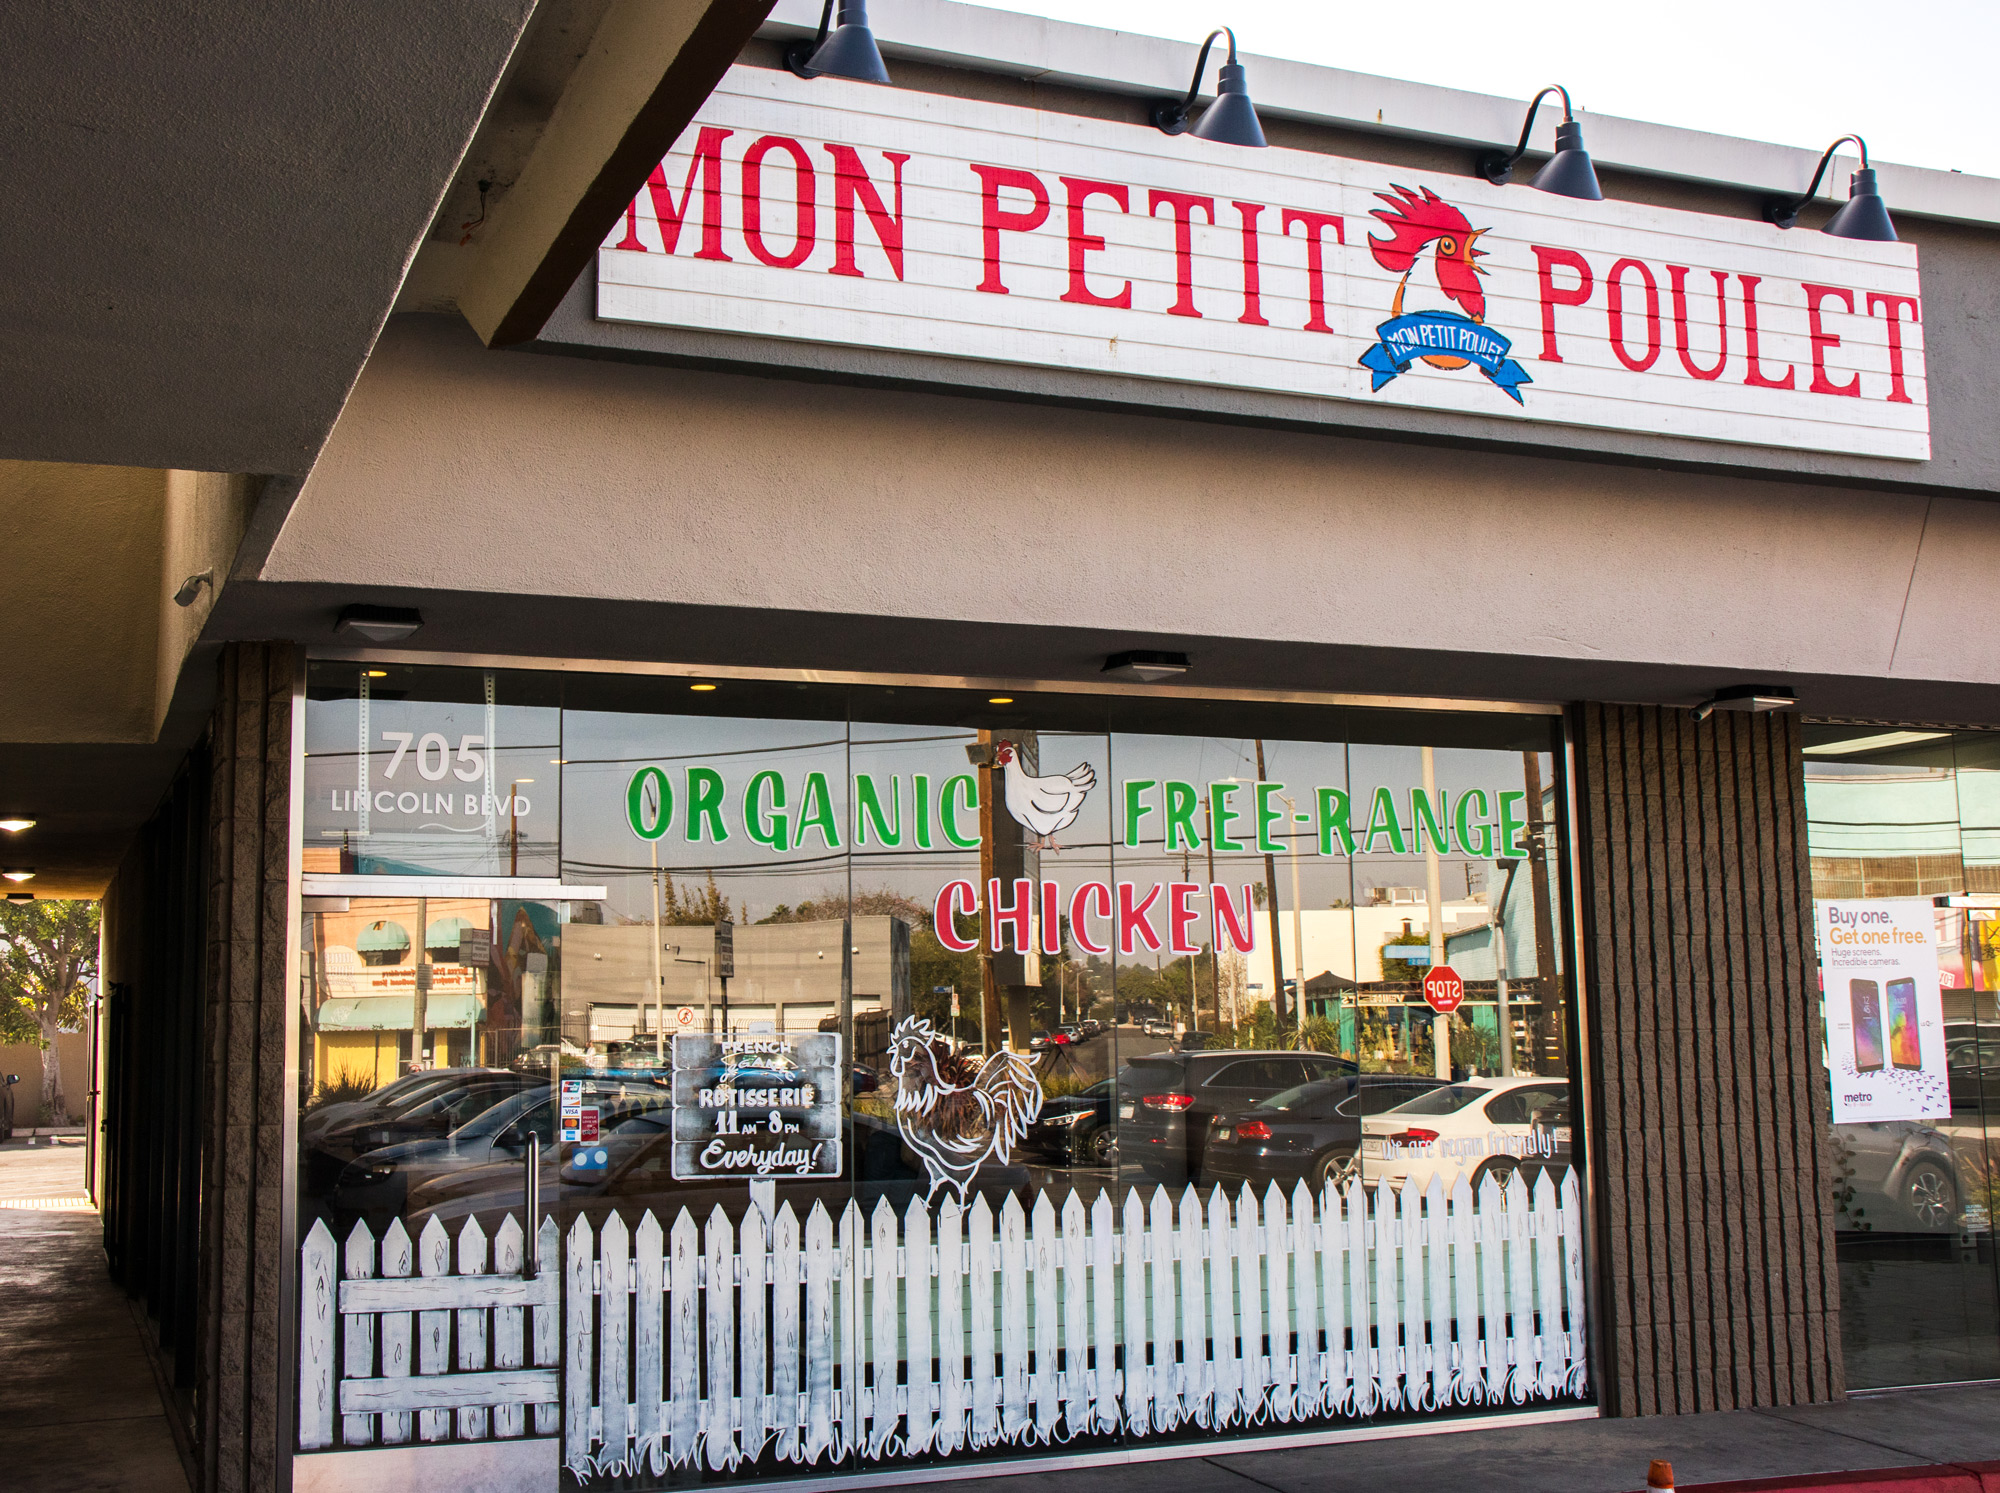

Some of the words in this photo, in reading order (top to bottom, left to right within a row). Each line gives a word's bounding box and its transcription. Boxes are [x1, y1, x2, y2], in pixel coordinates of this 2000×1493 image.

[616, 126, 911, 281] MON
[970, 163, 1345, 334] PETIT
[1531, 244, 1919, 404] POULET
[1387, 324, 1421, 357] MON
[1420, 324, 1457, 350] PETIT
[1459, 328, 1504, 365] POULET
[381, 731, 485, 783] 705
[331, 789, 453, 815] LINCOLN
[464, 793, 531, 817] BLVD
[624, 765, 983, 853] ORGANIC
[1122, 778, 1532, 860] FREE-RANGE
[933, 877, 1257, 956] CHICKEN
[1828, 906, 1858, 929] Buy
[1860, 911, 1893, 924] one.
[1829, 926, 1859, 945] Get
[1861, 931, 1890, 944] one
[1892, 926, 1927, 944] free.
[1831, 947, 1851, 958] Huge
[1852, 948, 1882, 956] screens.
[1832, 957, 1867, 966] Incredible
[1868, 958, 1901, 966] cameras.
[721, 1041, 792, 1054] FRENCH
[699, 1087, 815, 1109] ROTISSERIE
[1843, 1092, 1873, 1103] metro
[715, 1110, 741, 1136] 11
[741, 1123, 757, 1135] AM
[768, 1110, 783, 1134] 8
[784, 1123, 800, 1134] PM
[700, 1138, 823, 1175] Everyday!
[1382, 1139, 1402, 1161] we
[1408, 1139, 1435, 1159] are
[1440, 1136, 1485, 1166] vegan
[1488, 1126, 1559, 1159] friendly!
